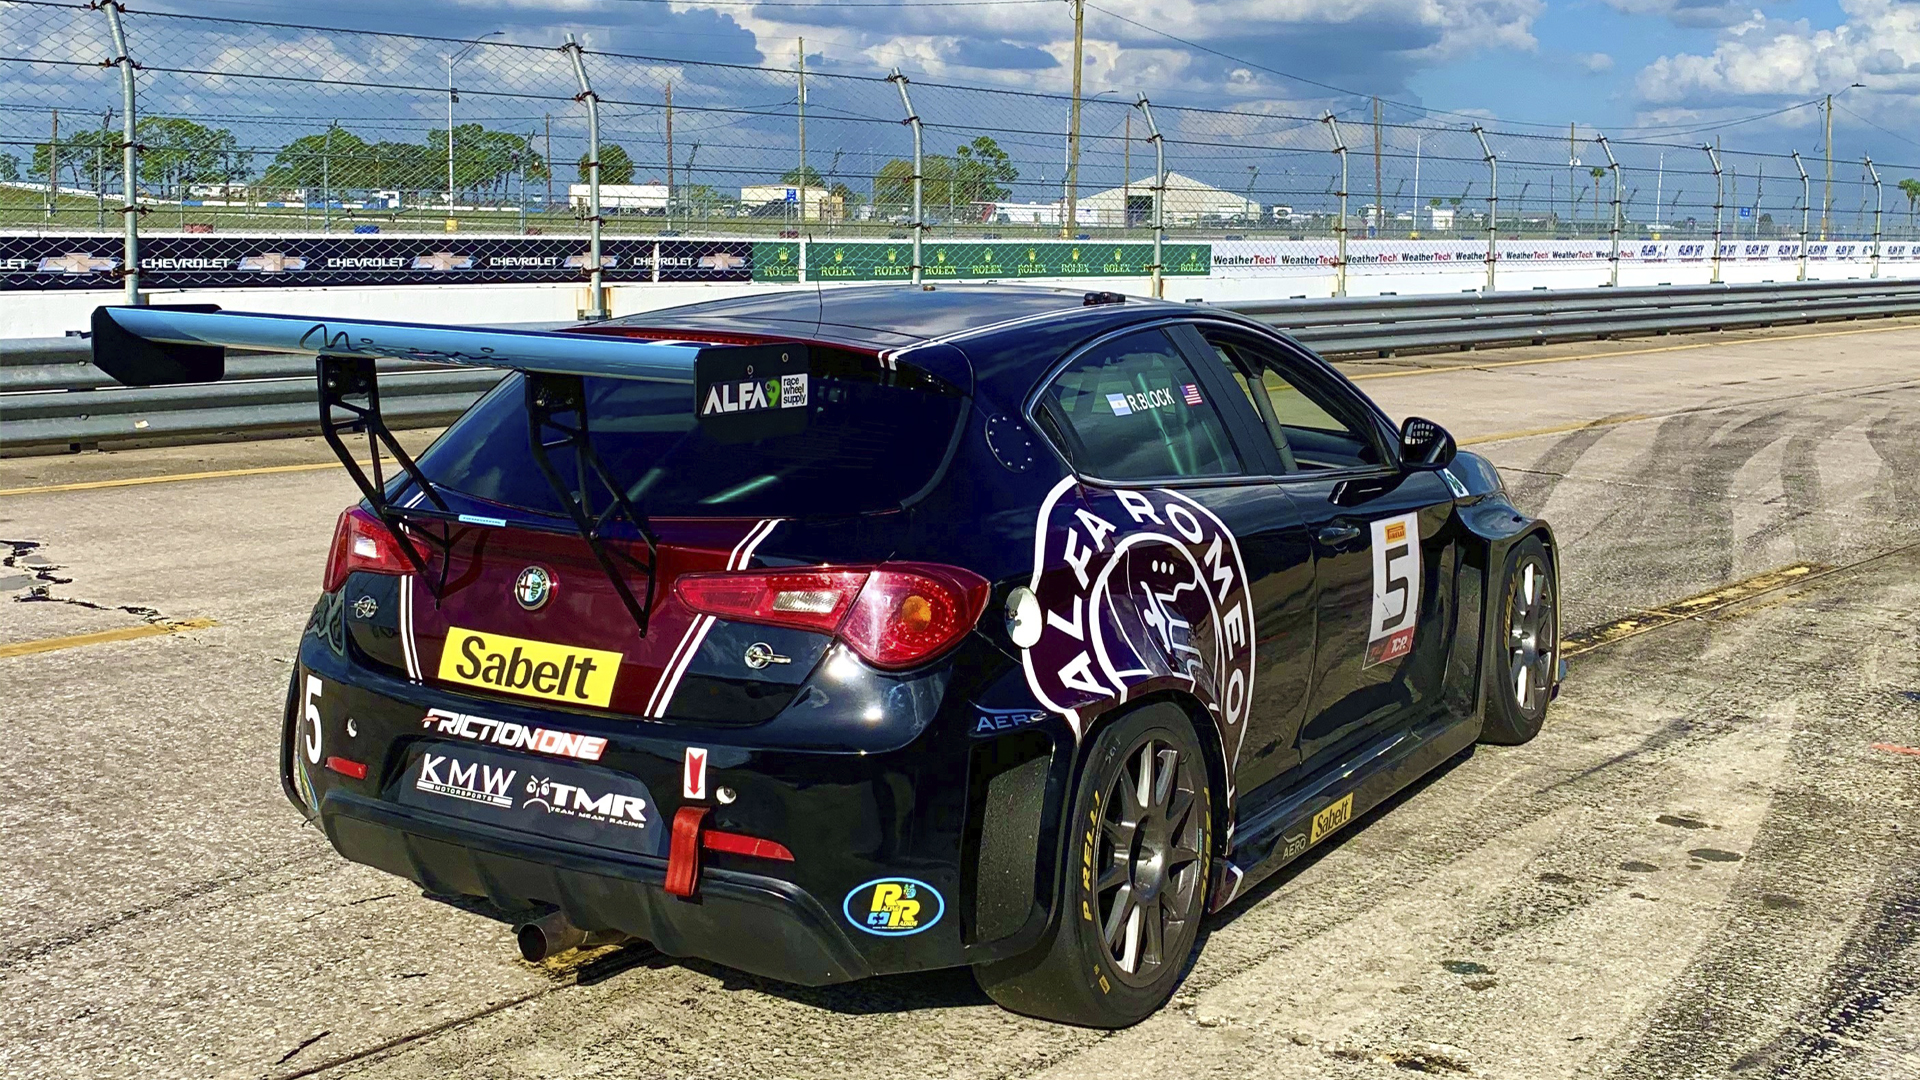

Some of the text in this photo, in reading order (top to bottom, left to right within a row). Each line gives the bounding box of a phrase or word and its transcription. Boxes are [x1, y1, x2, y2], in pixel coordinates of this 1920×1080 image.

[1213, 255, 1276, 265] WeatherTech
[1281, 255, 1339, 265] WeatherTech
[1345, 253, 1398, 263] WeatherTech
[1401, 252, 1451, 261] WeatherTech
[1456, 251, 1502, 260] WeatherTch
[1506, 251, 1549, 259] WeatherTech
[1552, 251, 1593, 259] WeatherTech
[142, 258, 231, 268] CHEVROLET
[327, 257, 405, 268] CHEVROLET
[490, 257, 558, 266] CHEVROLET
[633, 257, 693, 266] CHEROLET
[821, 266, 856, 276] ROLEX
[875, 266, 909, 276] ROLEX
[925, 266, 957, 275] ROLEX
[972, 265, 1003, 274] ROLEX
[1017, 264, 1046, 274] ROLEX
[1061, 264, 1090, 272] ROLEX
[783, 377, 800, 386] race
[783, 384, 805, 395] wheel
[783, 394, 807, 406] supply
[1127, 388, 1175, 412] R.BLOCK
[1382, 543, 1408, 632] 5
[1047, 489, 1246, 725] ALFA ROMEO
[456, 635, 597, 700] Sabelt
[305, 674, 323, 765] 5
[420, 753, 517, 797] KMW
[434, 785, 493, 802] MOTORSPORTS
[549, 782, 647, 822] TMR
[550, 806, 645, 829] TEAM MEAN RACING
[1316, 799, 1349, 838] Sabelt
[1282, 838, 1307, 860] AERO
[1083, 790, 1100, 921] PRELLI
